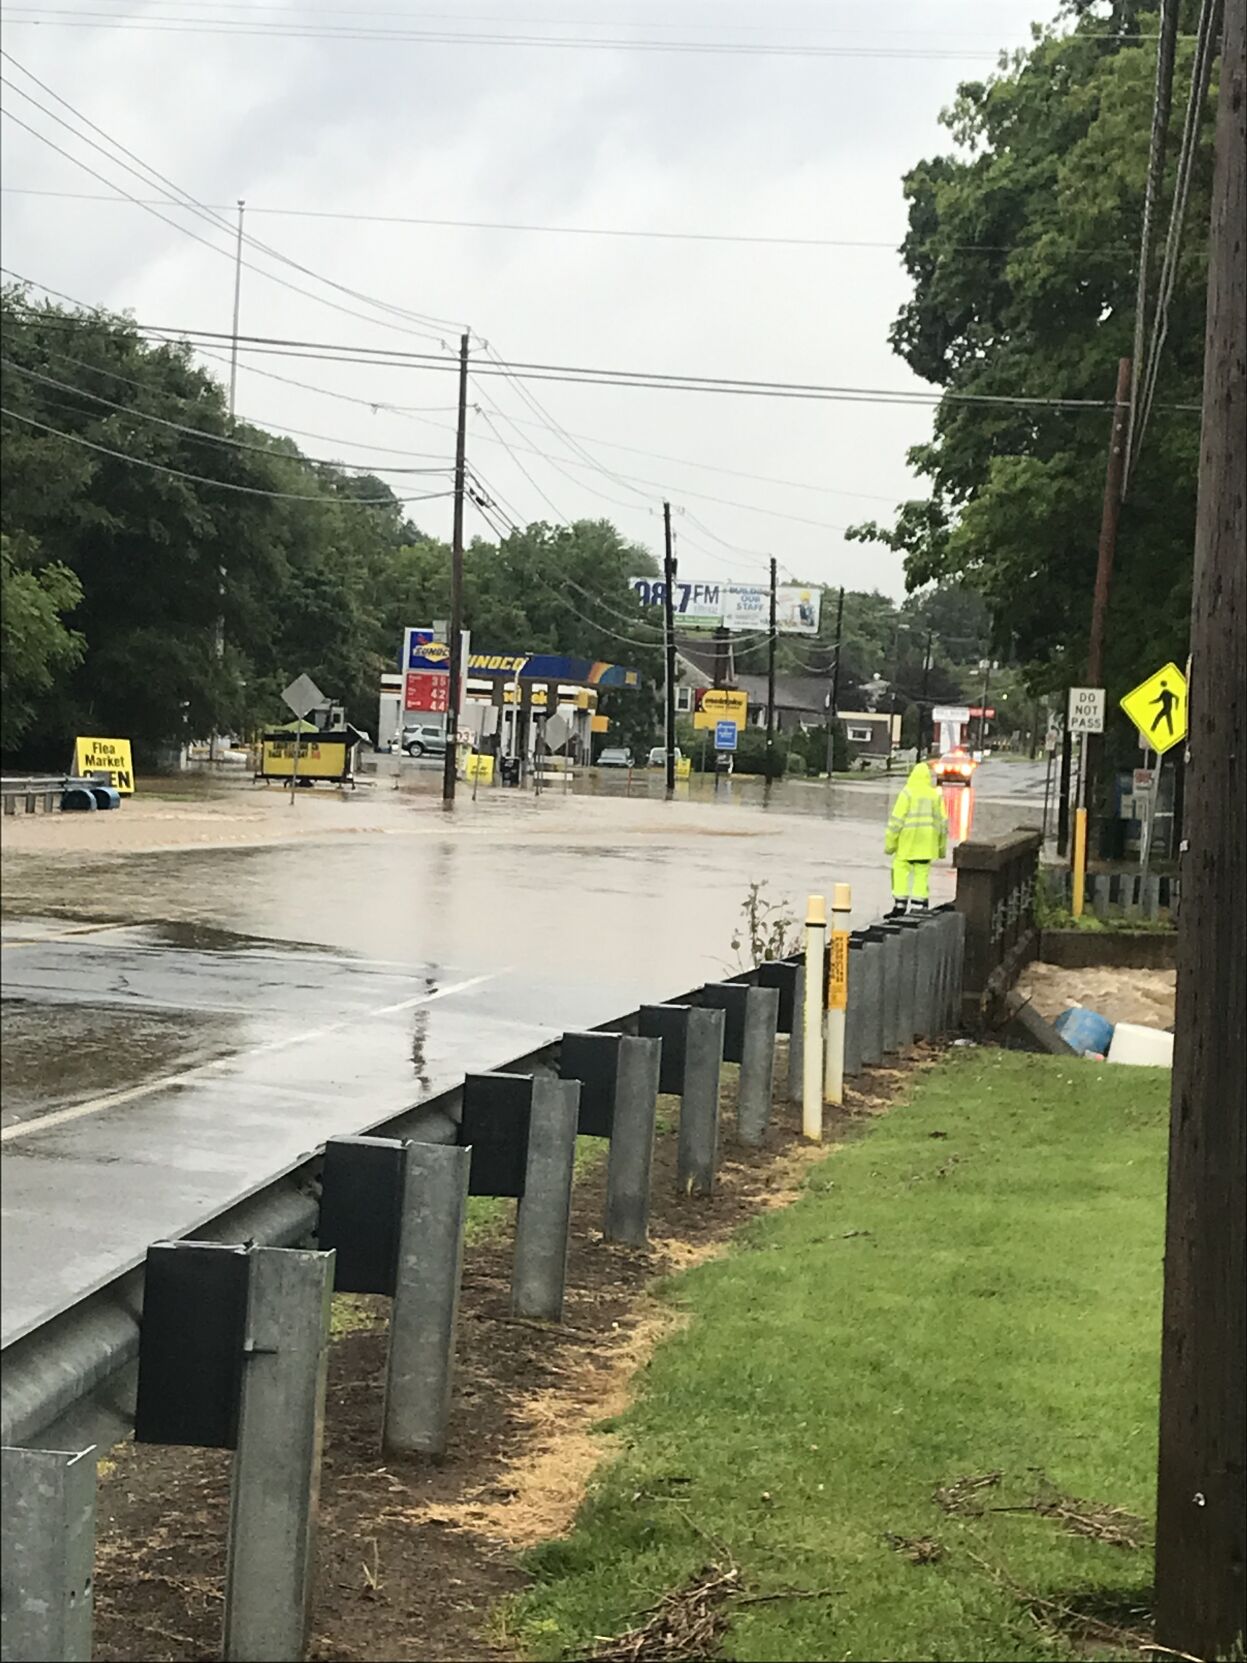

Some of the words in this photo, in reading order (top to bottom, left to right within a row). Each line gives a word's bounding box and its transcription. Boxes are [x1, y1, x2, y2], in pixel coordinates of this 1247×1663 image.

[694, 584, 719, 605] FM
[736, 603, 764, 612] STAFF
[413, 646, 451, 657] SUNOC
[1079, 692, 1096, 702] DO
[1075, 705, 1098, 715] NOT
[1071, 717, 1101, 729] PASS
[92, 742, 116, 755] Flea
[85, 754, 125, 768] Market
